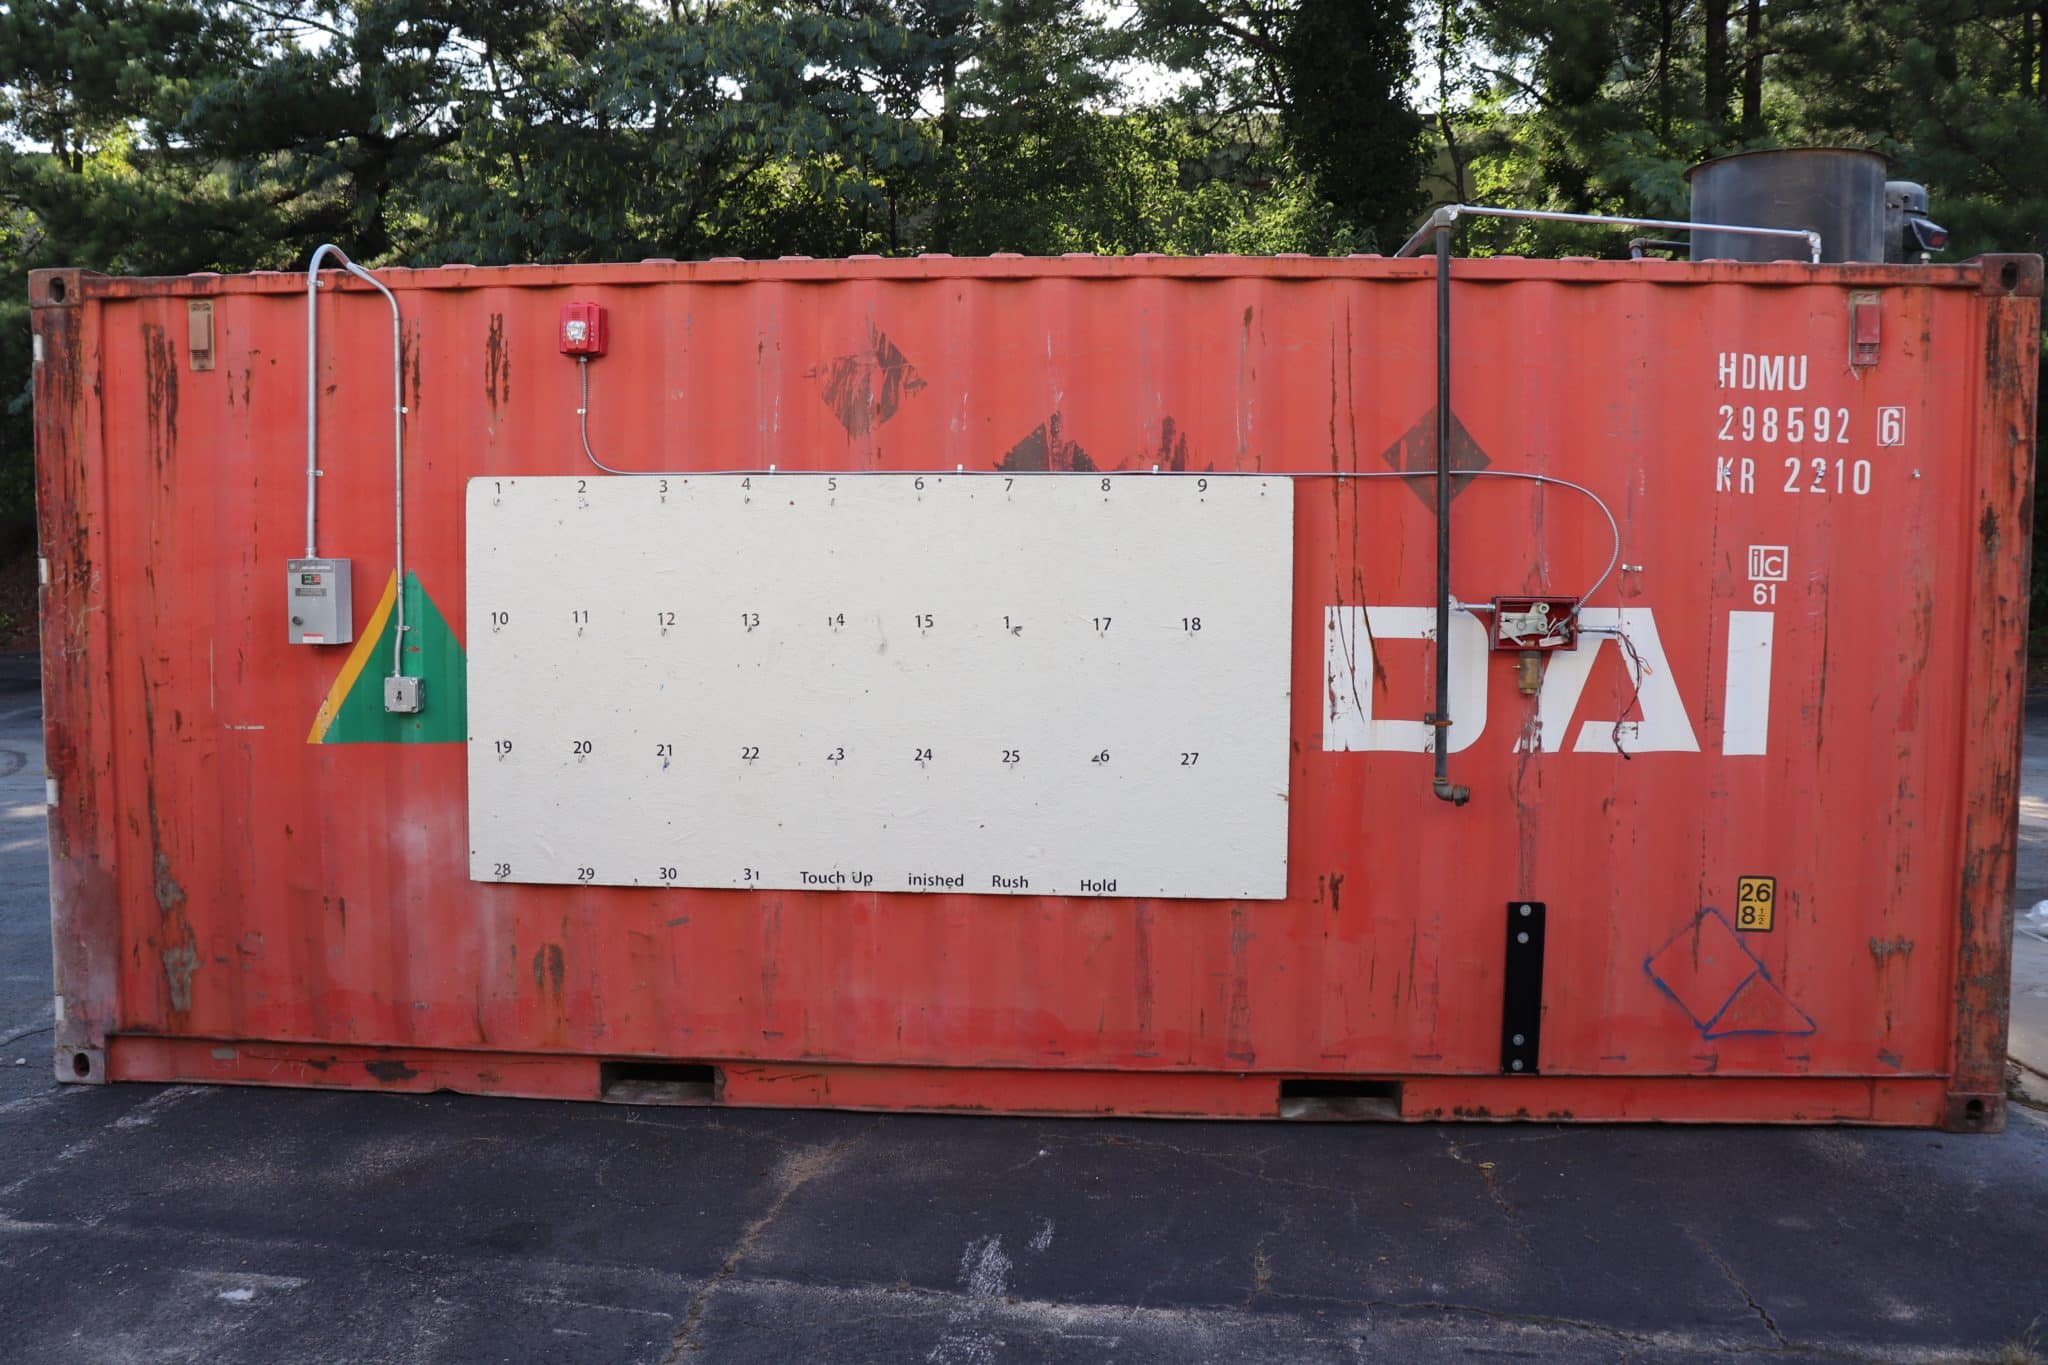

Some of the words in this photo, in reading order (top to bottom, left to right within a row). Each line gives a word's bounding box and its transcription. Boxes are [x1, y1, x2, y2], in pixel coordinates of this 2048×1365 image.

[1719, 352, 1808, 391] HDMU
[1718, 405, 1849, 444] 298592
[1882, 408, 1900, 444] 6
[495, 482, 501, 494] 1
[577, 480, 587, 494] 2
[659, 479, 668, 493] 3
[741, 477, 752, 491] 4
[828, 477, 838, 492] 5
[914, 476, 925, 490] 6
[1004, 478, 1014, 492] 7
[1100, 478, 1111, 492] 8
[1197, 478, 1208, 492] 9
[1716, 456, 1755, 494] KR
[1784, 457, 1871, 495] 2210
[1753, 583, 1776, 605] 61
[491, 611, 509, 625] 10
[572, 610, 588, 624] 11
[657, 612, 675, 626] 12
[741, 613, 760, 627] 13
[828, 613, 845, 627] 14
[915, 614, 934, 629] 15
[1093, 617, 1112, 631] 17
[1182, 616, 1202, 632] 18
[1322, 605, 1775, 755] DAI
[494, 740, 513, 754] 19
[573, 740, 593, 755] 20
[656, 743, 673, 757] 21
[741, 746, 760, 761] 22
[914, 748, 933, 762] 24
[1002, 749, 1021, 763] 25
[1180, 752, 1200, 766] 27
[493, 862, 512, 878] 28
[577, 867, 595, 881] 29
[659, 866, 678, 880] 30
[743, 867, 760, 881] 31
[799, 870, 846, 885] Touch
[851, 871, 874, 888] Up
[991, 874, 1029, 889] Rush
[1080, 878, 1117, 893] Hold
[1741, 883, 1771, 902] 2.6
